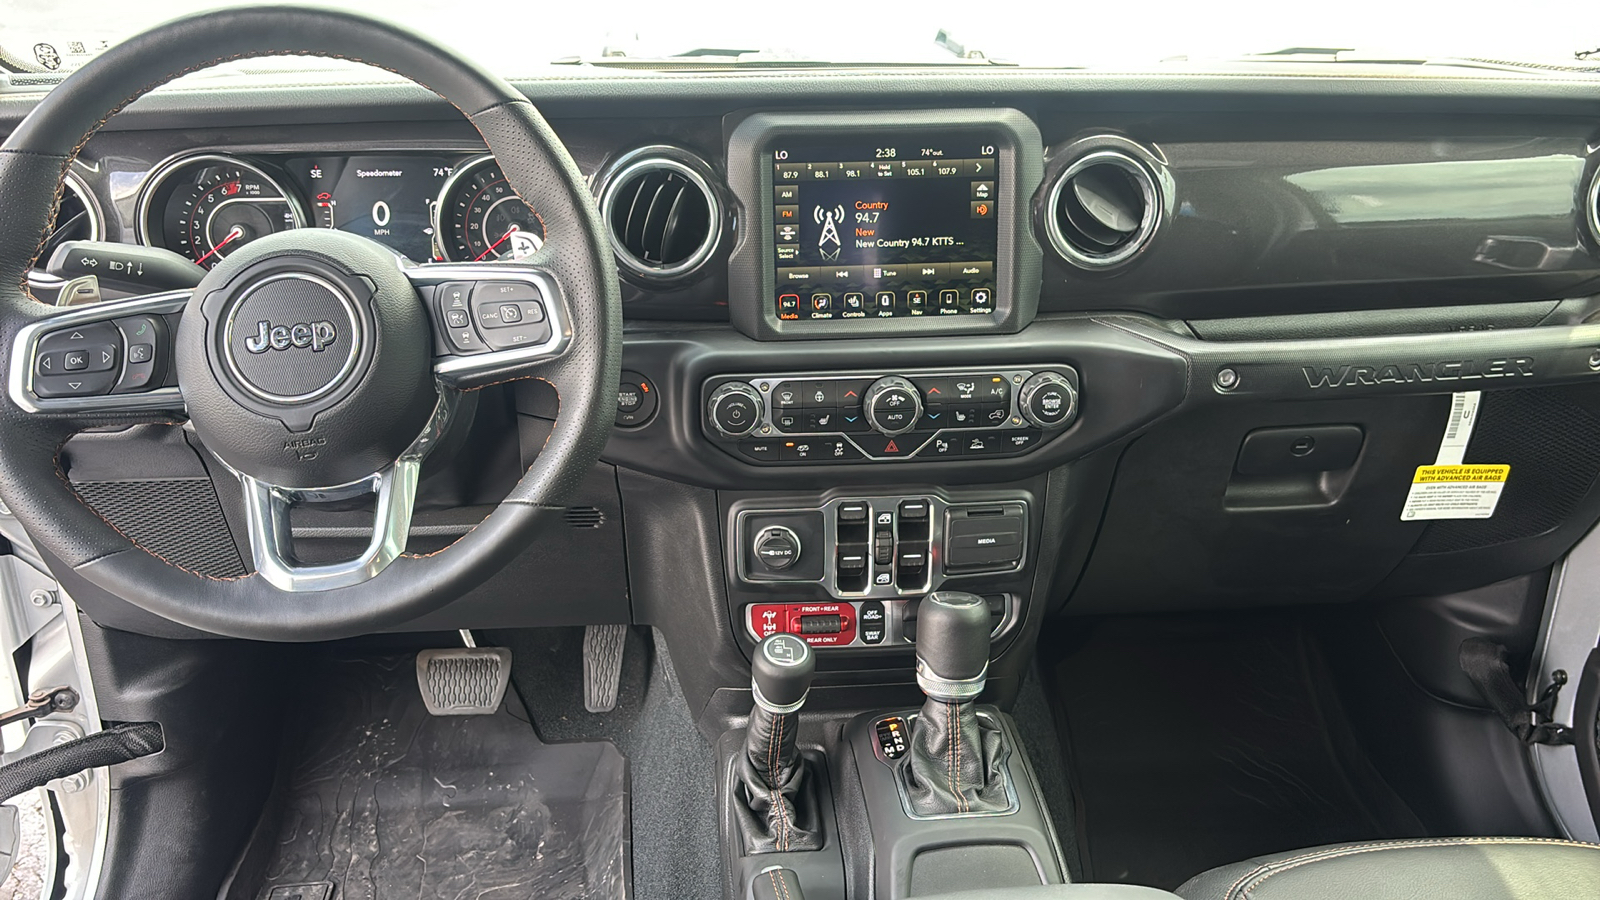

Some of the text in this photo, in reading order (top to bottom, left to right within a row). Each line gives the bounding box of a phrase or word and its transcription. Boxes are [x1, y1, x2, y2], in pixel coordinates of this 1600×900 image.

[775, 150, 788, 160] LO
[875, 148, 896, 158] 2:38
[981, 146, 994, 155] LO
[310, 170, 322, 178] SE
[356, 169, 403, 178] Speedometer
[783, 171, 798, 179] 87.9
[221, 187, 227, 195] 6
[236, 184, 242, 193] 7
[495, 186, 504, 194] 50
[207, 194, 215, 202] 5
[197, 206, 204, 214] 4
[855, 201, 888, 211] Country
[372, 200, 390, 227] 0
[855, 212, 880, 224] 94.7
[194, 220, 200, 229] 3
[855, 228, 875, 237] New
[194, 236, 201, 244] 2
[856, 239, 875, 248] New
[876, 239, 910, 248] Country
[911, 237, 929, 246] 94.7
[932, 237, 954, 246] KTTS
[245, 320, 337, 354] Jeep
[70, 356, 84, 364] OK
[1302, 356, 1534, 388] WRANGLER
[283, 438, 326, 450] AIRBAG
[889, 723, 898, 731] P
[892, 730, 901, 738] R
[884, 746, 895, 754] M
[896, 744, 904, 752] D
